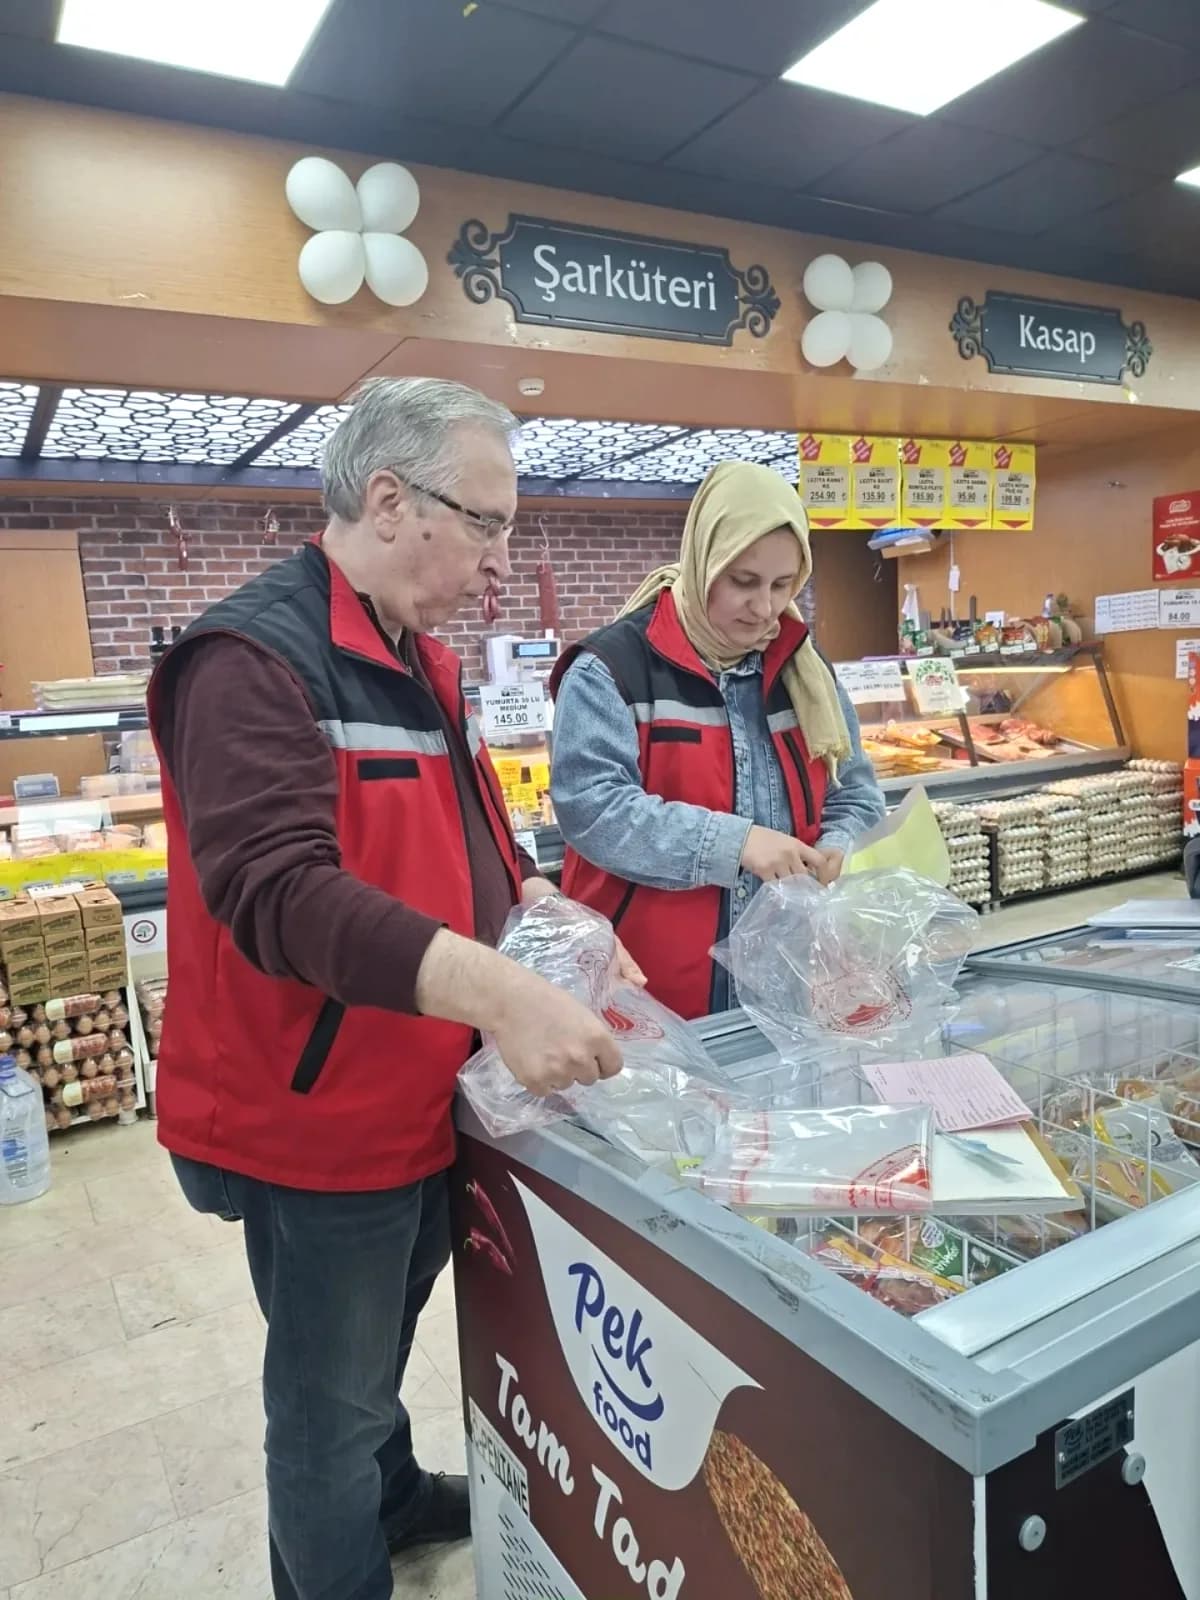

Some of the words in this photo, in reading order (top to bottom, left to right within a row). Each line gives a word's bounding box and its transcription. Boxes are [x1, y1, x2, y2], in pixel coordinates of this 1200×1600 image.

[534, 244, 717, 311] Şarküteri
[1019, 313, 1096, 364] Kasap
[810, 491, 836, 500] 254.90
[486, 698, 520, 706] YUMURTA
[494, 712, 528, 725] 145.00
[567, 1262, 653, 1389] Pek
[495, 1353, 575, 1496] Tam
[593, 1381, 652, 1470] food
